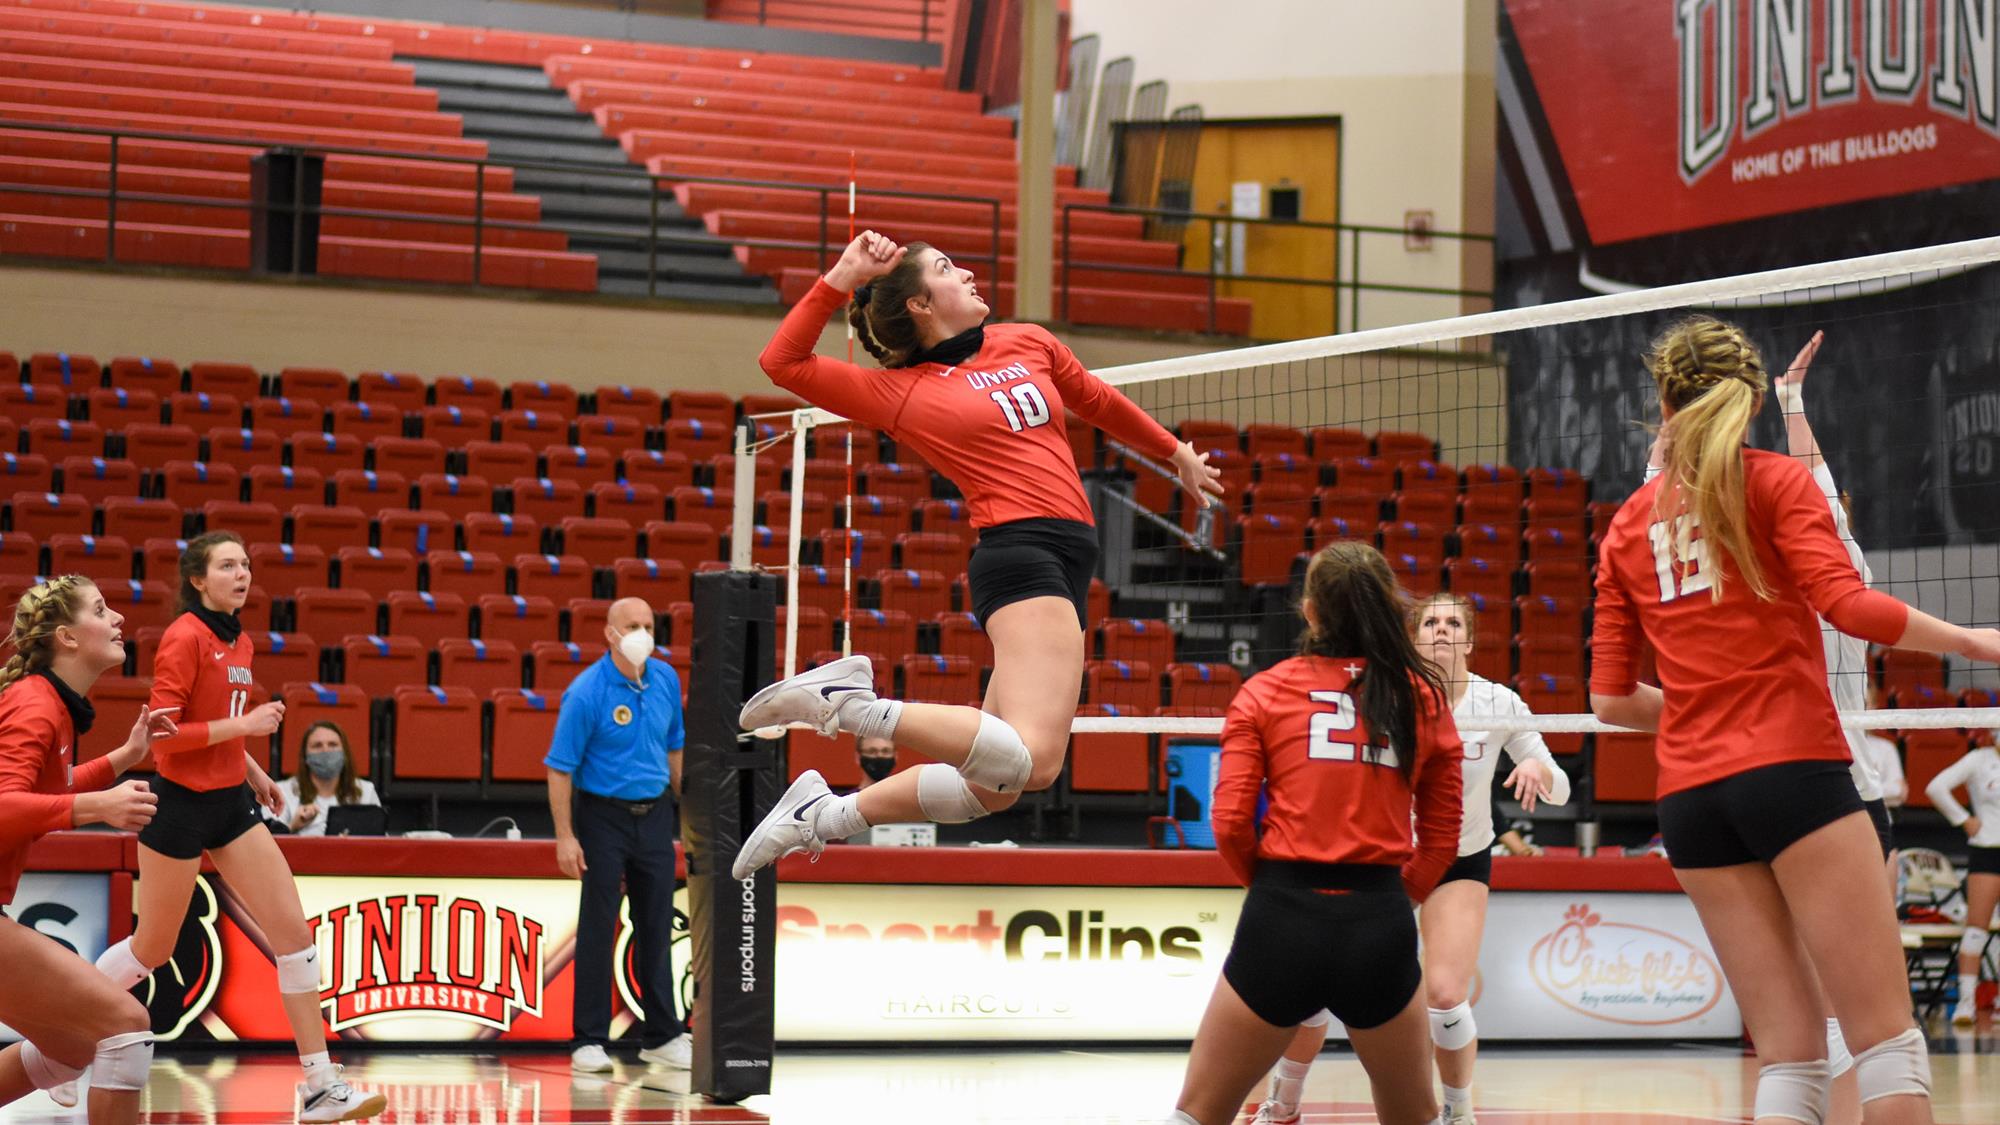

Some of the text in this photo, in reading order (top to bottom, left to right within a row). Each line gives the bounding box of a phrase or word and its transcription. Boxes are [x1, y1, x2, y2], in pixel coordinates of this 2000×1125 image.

[1674, 0, 2000, 187] UNION
[1732, 124, 1937, 182] HOME OF THE BULLDOGS
[990, 382, 1050, 432] 10
[228, 665, 253, 686] UNION
[306, 894, 543, 1011] UNION
[739, 872, 757, 993] ports imports
[353, 985, 489, 1013] UNIVERSITY
